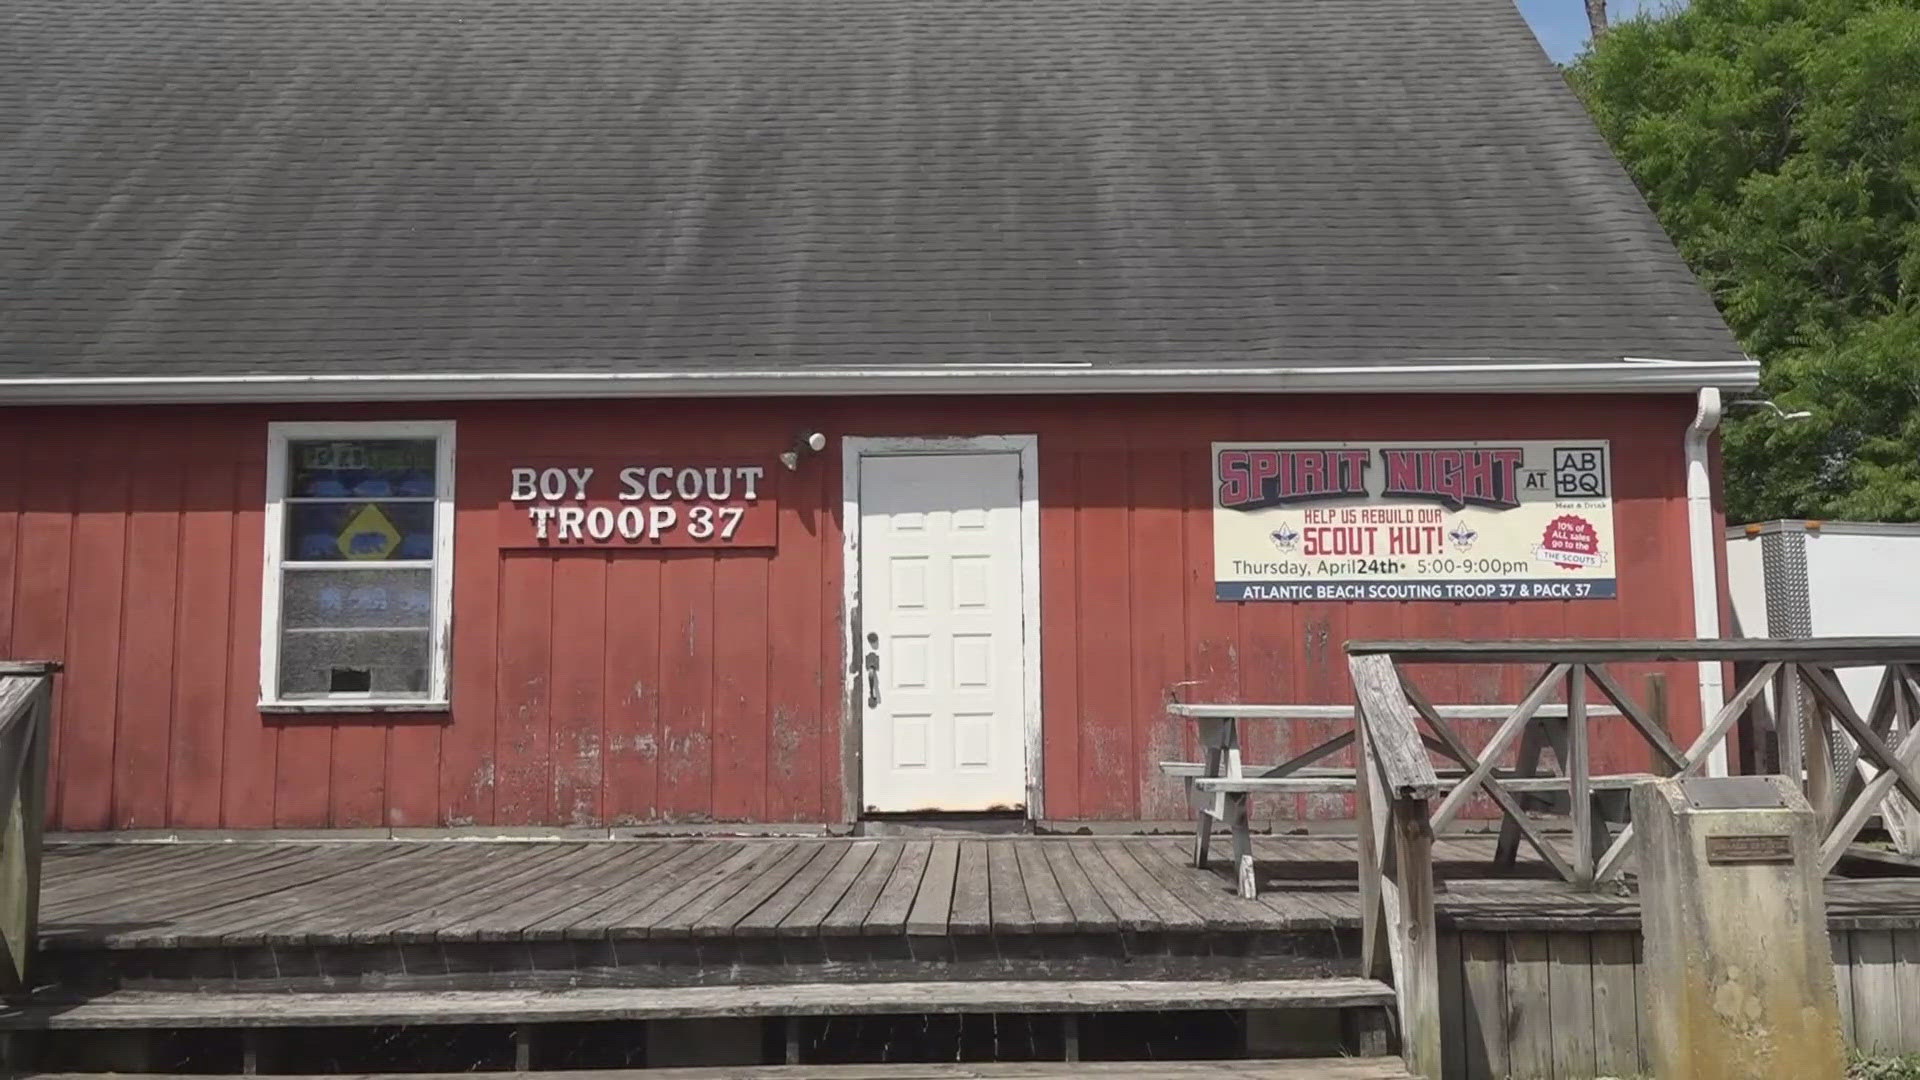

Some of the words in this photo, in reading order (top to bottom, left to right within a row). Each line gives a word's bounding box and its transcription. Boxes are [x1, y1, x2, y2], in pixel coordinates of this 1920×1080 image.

[1559, 453, 1597, 472] AB
[510, 467, 594, 501] BOY
[618, 467, 764, 501] SCOUT
[1219, 449, 1371, 512] SPIRIT
[1380, 447, 1524, 512] NIGHT
[1525, 472, 1548, 488] AT
[1559, 473, 1603, 496] BQ
[529, 506, 677, 539] TROOP
[687, 506, 744, 539] 37
[1304, 509, 1336, 524] HELP
[1341, 509, 1357, 523] US
[1361, 509, 1414, 523] REBUILD
[1418, 509, 1442, 523] OUR
[1557, 522, 1574, 531] 10%
[1575, 525, 1585, 533] of
[1303, 526, 1378, 555] SCOUT
[1389, 526, 1443, 555] HUT!
[1552, 530, 1568, 539] ALL
[1570, 534, 1590, 542] sales
[1552, 540, 1563, 549] go
[1564, 541, 1574, 549] to
[1575, 542, 1590, 551] the
[1544, 552, 1560, 560] THE
[1562, 554, 1596, 565] SCOUTS
[1233, 560, 1311, 576] Thursday,
[1417, 559, 1528, 575] 5:00-9:00pm
[1243, 585, 1312, 599] ATLANTIC
[1317, 585, 1364, 598] BEACH
[1369, 585, 1442, 599] SCOUTING
[1446, 585, 1496, 598] TROOP
[1500, 584, 1516, 597] 37
[1519, 584, 1530, 597] &
[1533, 584, 1571, 597] PACK
[1575, 584, 1591, 596] 37
